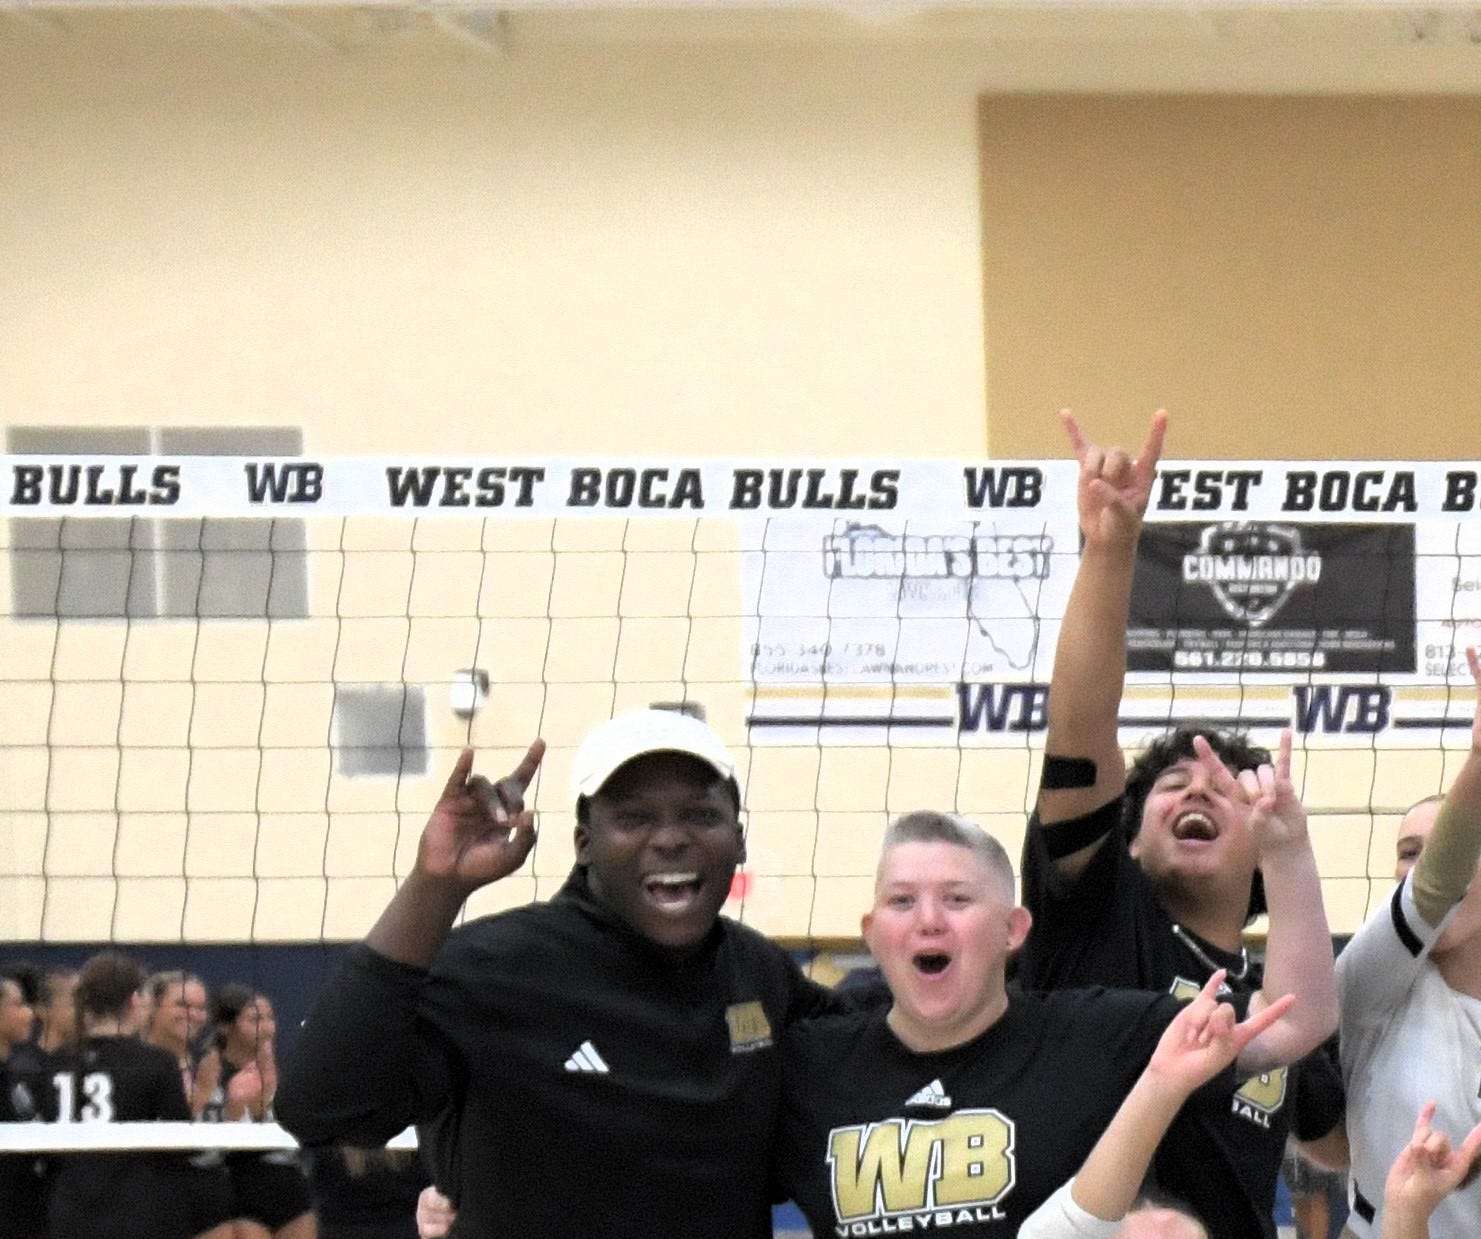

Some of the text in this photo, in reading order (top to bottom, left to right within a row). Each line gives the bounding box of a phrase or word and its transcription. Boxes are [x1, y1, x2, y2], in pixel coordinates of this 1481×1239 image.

[10, 465, 181, 505] BULLS
[244, 463, 325, 503] WB
[385, 467, 901, 510] WEST BOCA BULLS
[963, 467, 1044, 508] WB
[1153, 469, 1264, 511] EST
[1281, 470, 1419, 512] BOCA
[1182, 554, 1322, 583] COMMANDO
[957, 683, 1050, 733] WB
[1293, 685, 1393, 734] WB
[53, 1071, 114, 1124] 13
[825, 1108, 1016, 1224] WB
[835, 1206, 1006, 1239] VOLLEYBALL
